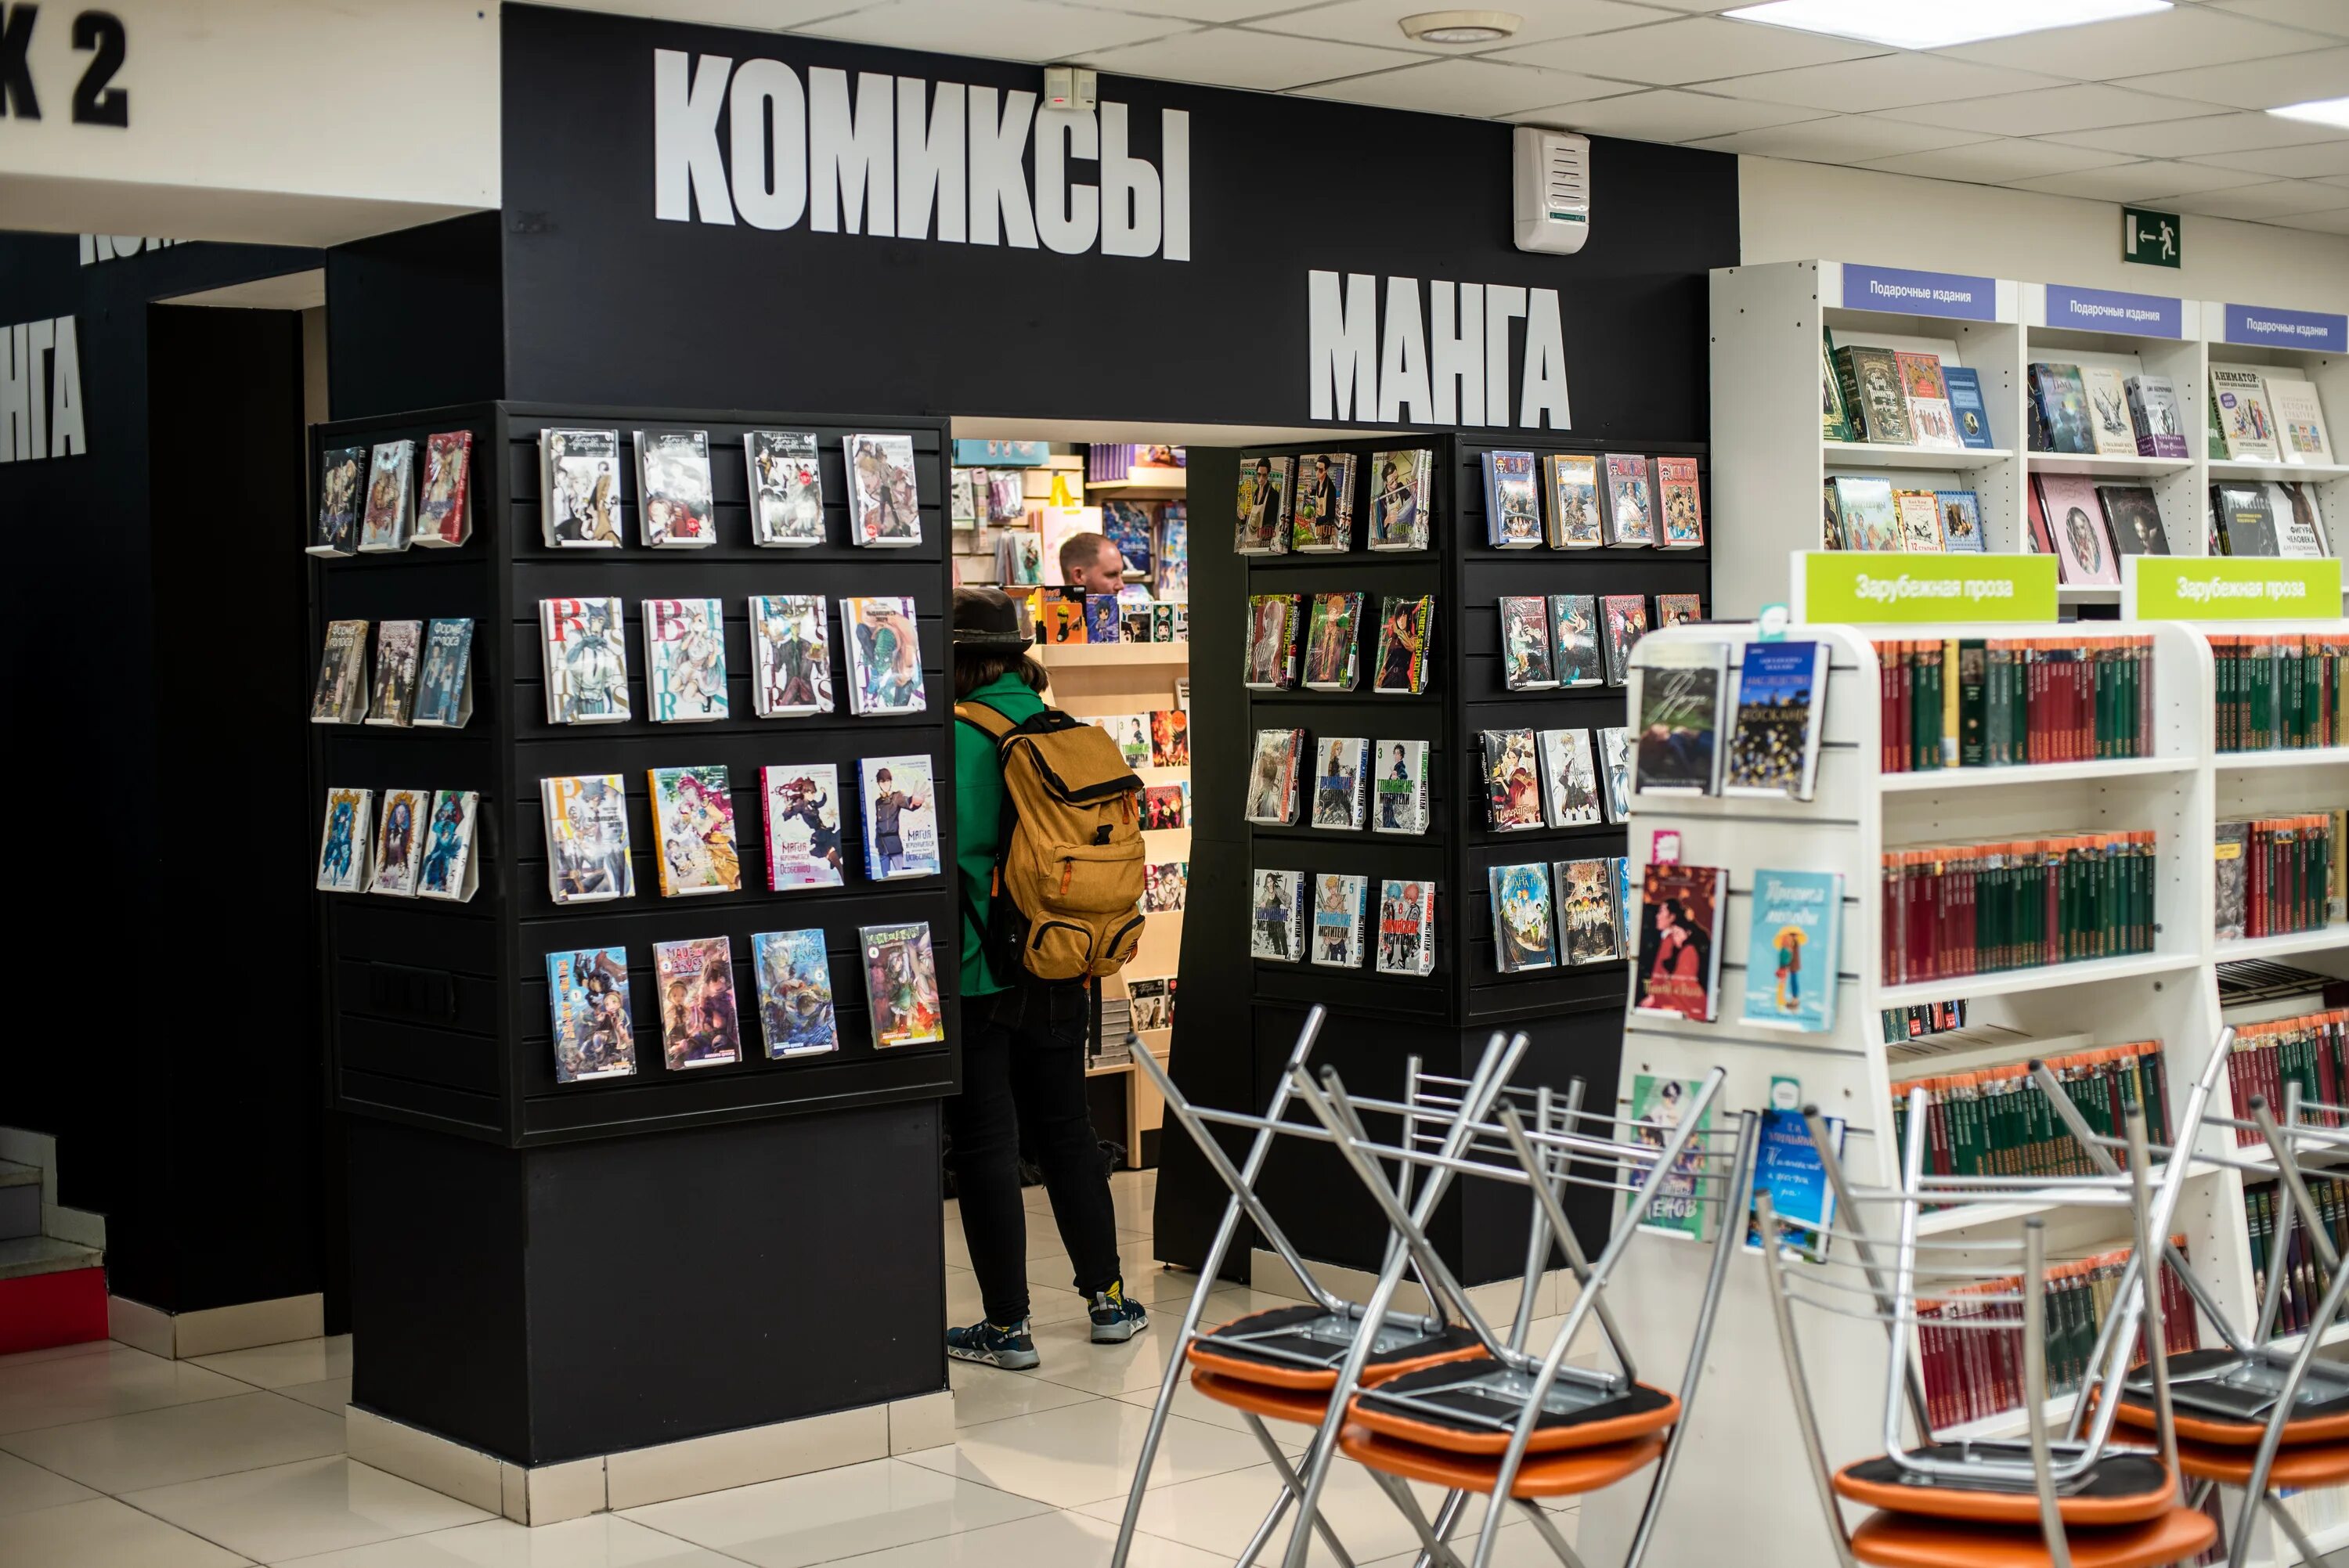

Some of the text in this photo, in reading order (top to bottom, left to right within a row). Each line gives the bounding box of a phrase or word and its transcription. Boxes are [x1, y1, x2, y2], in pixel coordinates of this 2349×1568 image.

[71, 10, 128, 128] 2
[655, 49, 1190, 261] КОМИКСЫ
[1870, 280, 1972, 303] Подарочные издания
[2070, 300, 2160, 322] Подарочные издания
[2246, 317, 2328, 337] Подарочные издания
[1308, 269, 1571, 430] МАНГА
[2215, 371, 2260, 383] АНИМАТОР:
[693, 433, 704, 442] 02
[2290, 526, 2314, 535] ФИГУРА
[1911, 542, 1918, 551] 12
[1855, 574, 2013, 602] Зарубежная проза
[2177, 576, 2306, 602] Зарубежная проза
[1340, 668, 1347, 678] 6
[1319, 745, 1324, 756] 2
[1378, 748, 1383, 759] 3
[1357, 777, 1366, 806] МСТИТЕЛИ
[1255, 876, 1260, 888] 4
[1349, 882, 1354, 894] 5
[1398, 903, 1403, 914] 8
[1318, 926, 1348, 939] МСТИТЕЛИ
[1423, 922, 1432, 951] МСТИТЕЛИ
